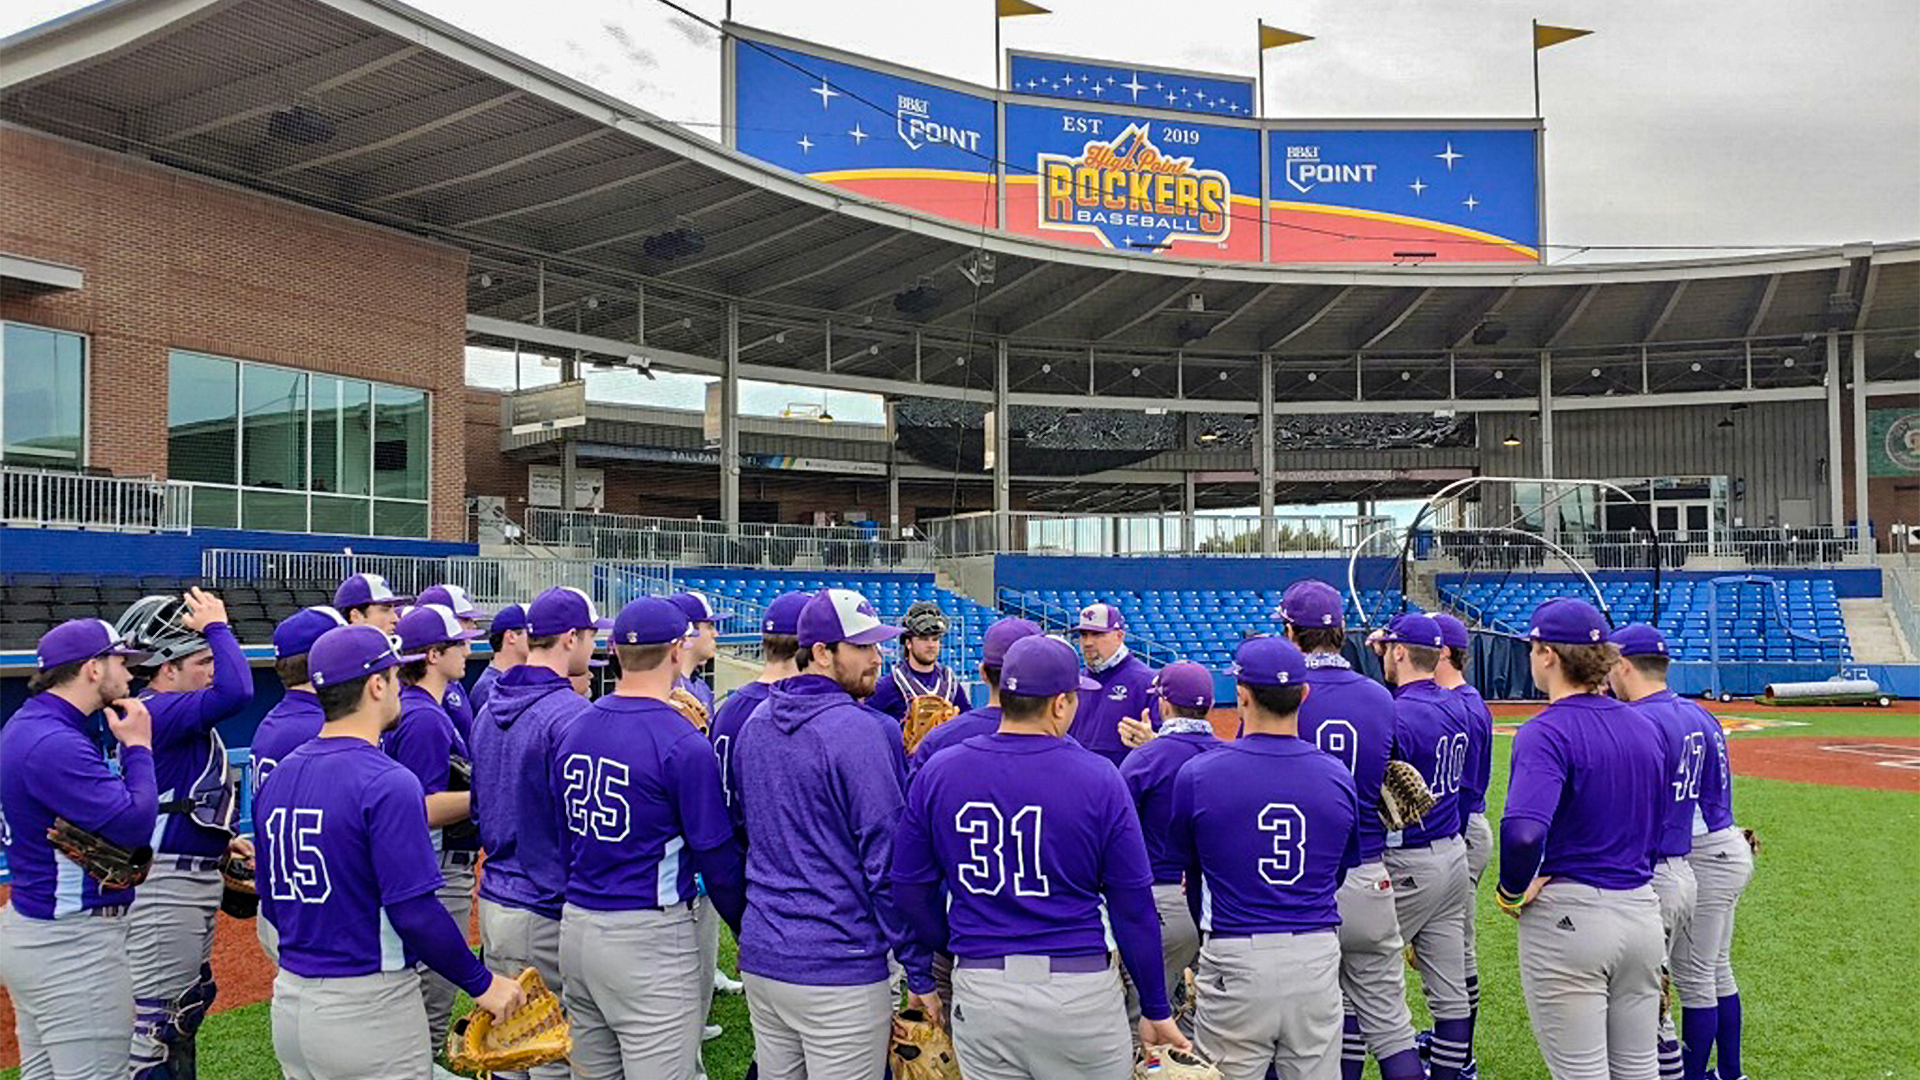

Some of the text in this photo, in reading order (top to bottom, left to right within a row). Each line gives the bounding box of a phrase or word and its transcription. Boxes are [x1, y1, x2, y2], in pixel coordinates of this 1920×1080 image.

[898, 95, 930, 113] BB&T
[910, 118, 981, 152] POINT
[1163, 127, 1200, 145] 2019
[1287, 146, 1319, 158] BB&T
[1084, 136, 1188, 173] High Point
[1300, 164, 1377, 182] POINT
[1049, 163, 1225, 233] ROCKERS
[1077, 210, 1199, 232] BASEBALL
[671, 450, 721, 466] BALLPAR
[1316, 719, 1358, 777] 9
[1430, 732, 1469, 800] 10
[564, 753, 630, 843] 25
[265, 807, 332, 904] 15
[955, 801, 1050, 897] 31
[1257, 803, 1306, 886] 3
